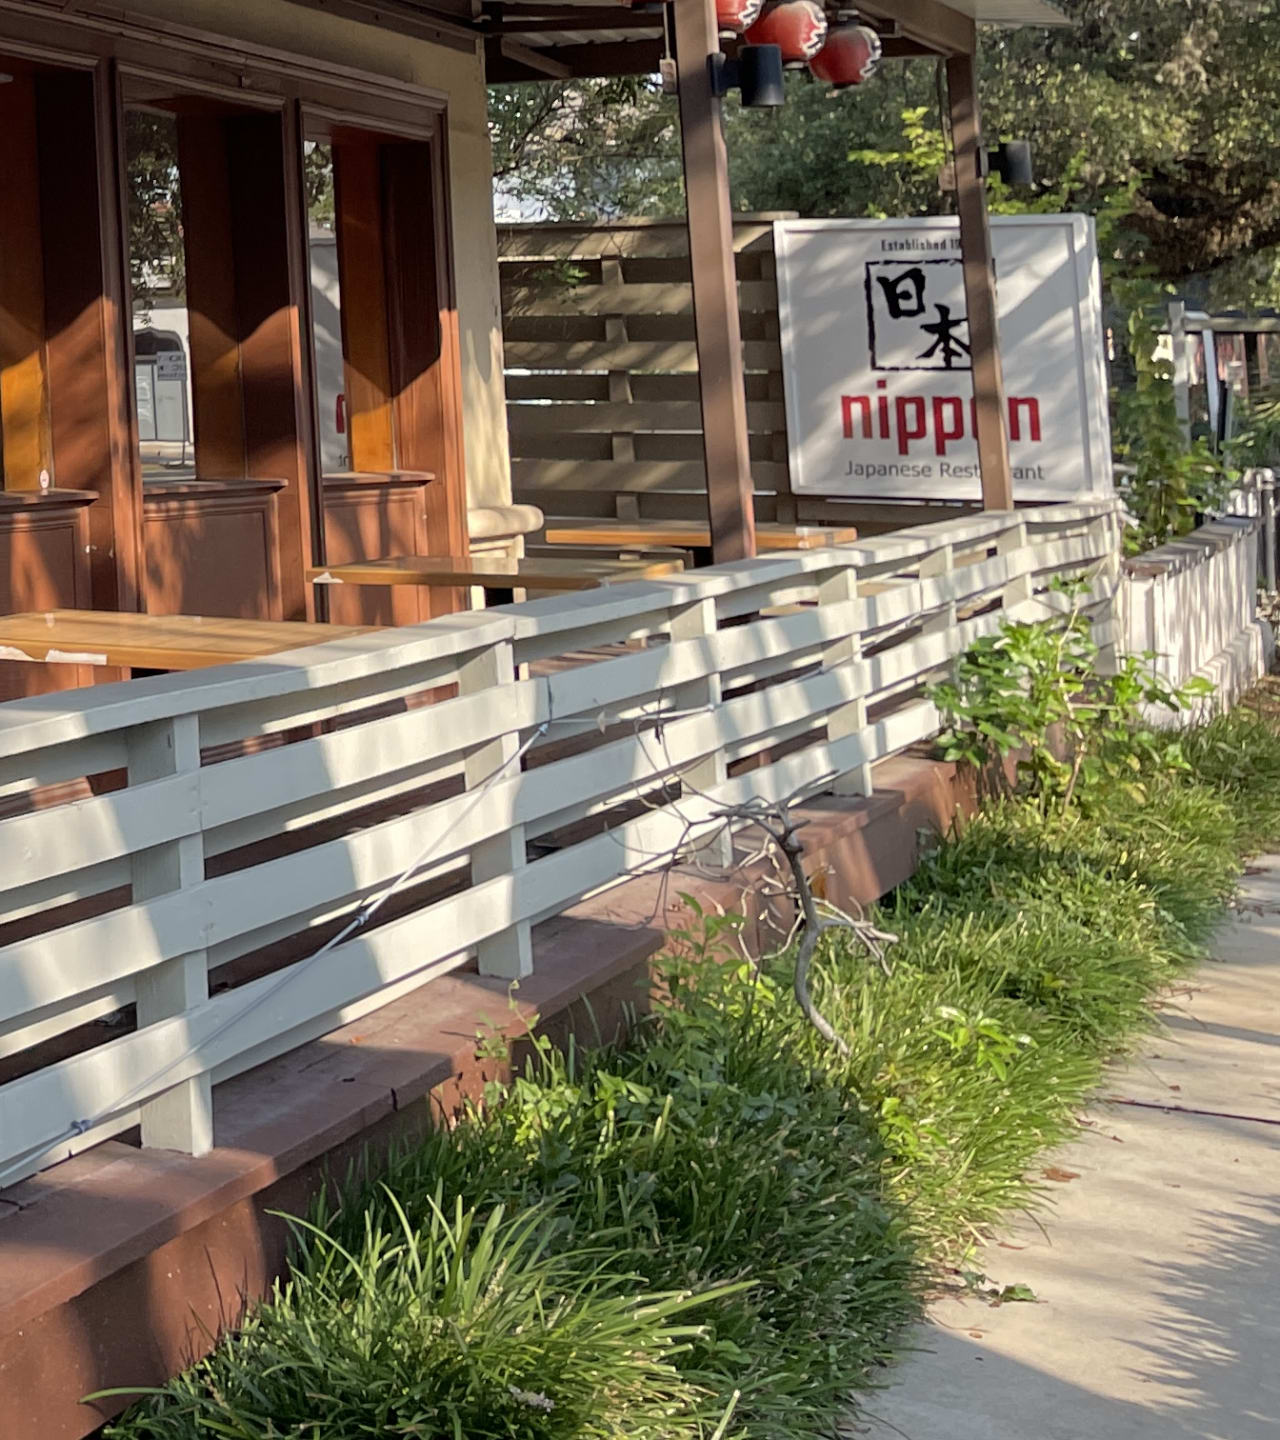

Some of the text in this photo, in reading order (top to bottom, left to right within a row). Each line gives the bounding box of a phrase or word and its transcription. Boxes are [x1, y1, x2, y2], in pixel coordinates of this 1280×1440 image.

[881, 236, 947, 251] Established
[841, 379, 1041, 456] nippn
[845, 461, 1045, 481] Japanese Restant
